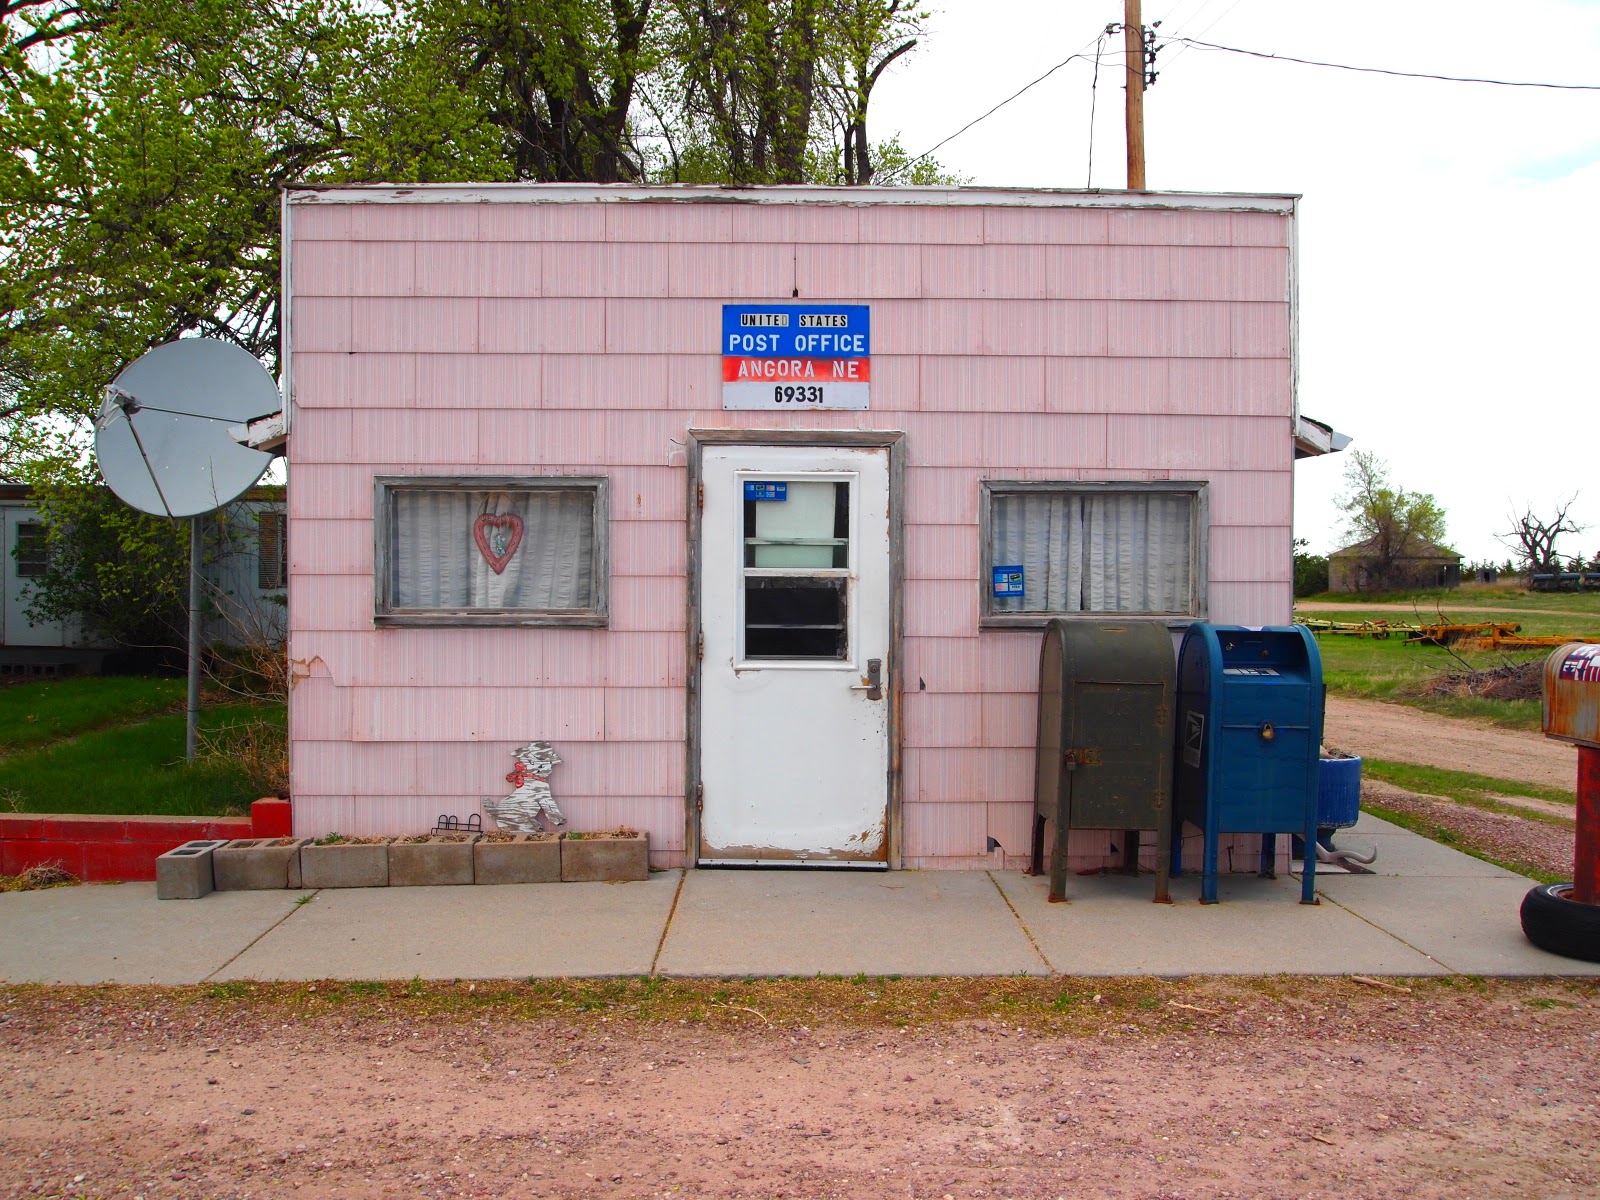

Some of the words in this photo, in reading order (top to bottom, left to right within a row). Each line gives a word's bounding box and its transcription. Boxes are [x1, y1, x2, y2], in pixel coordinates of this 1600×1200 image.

[741, 314, 788, 326] UNITED
[800, 315, 847, 327] STATES
[729, 334, 780, 352] POST
[794, 334, 865, 352] OFFICE
[738, 359, 815, 378] ANGORA
[832, 361, 859, 379] NE
[774, 386, 824, 404] 69331
